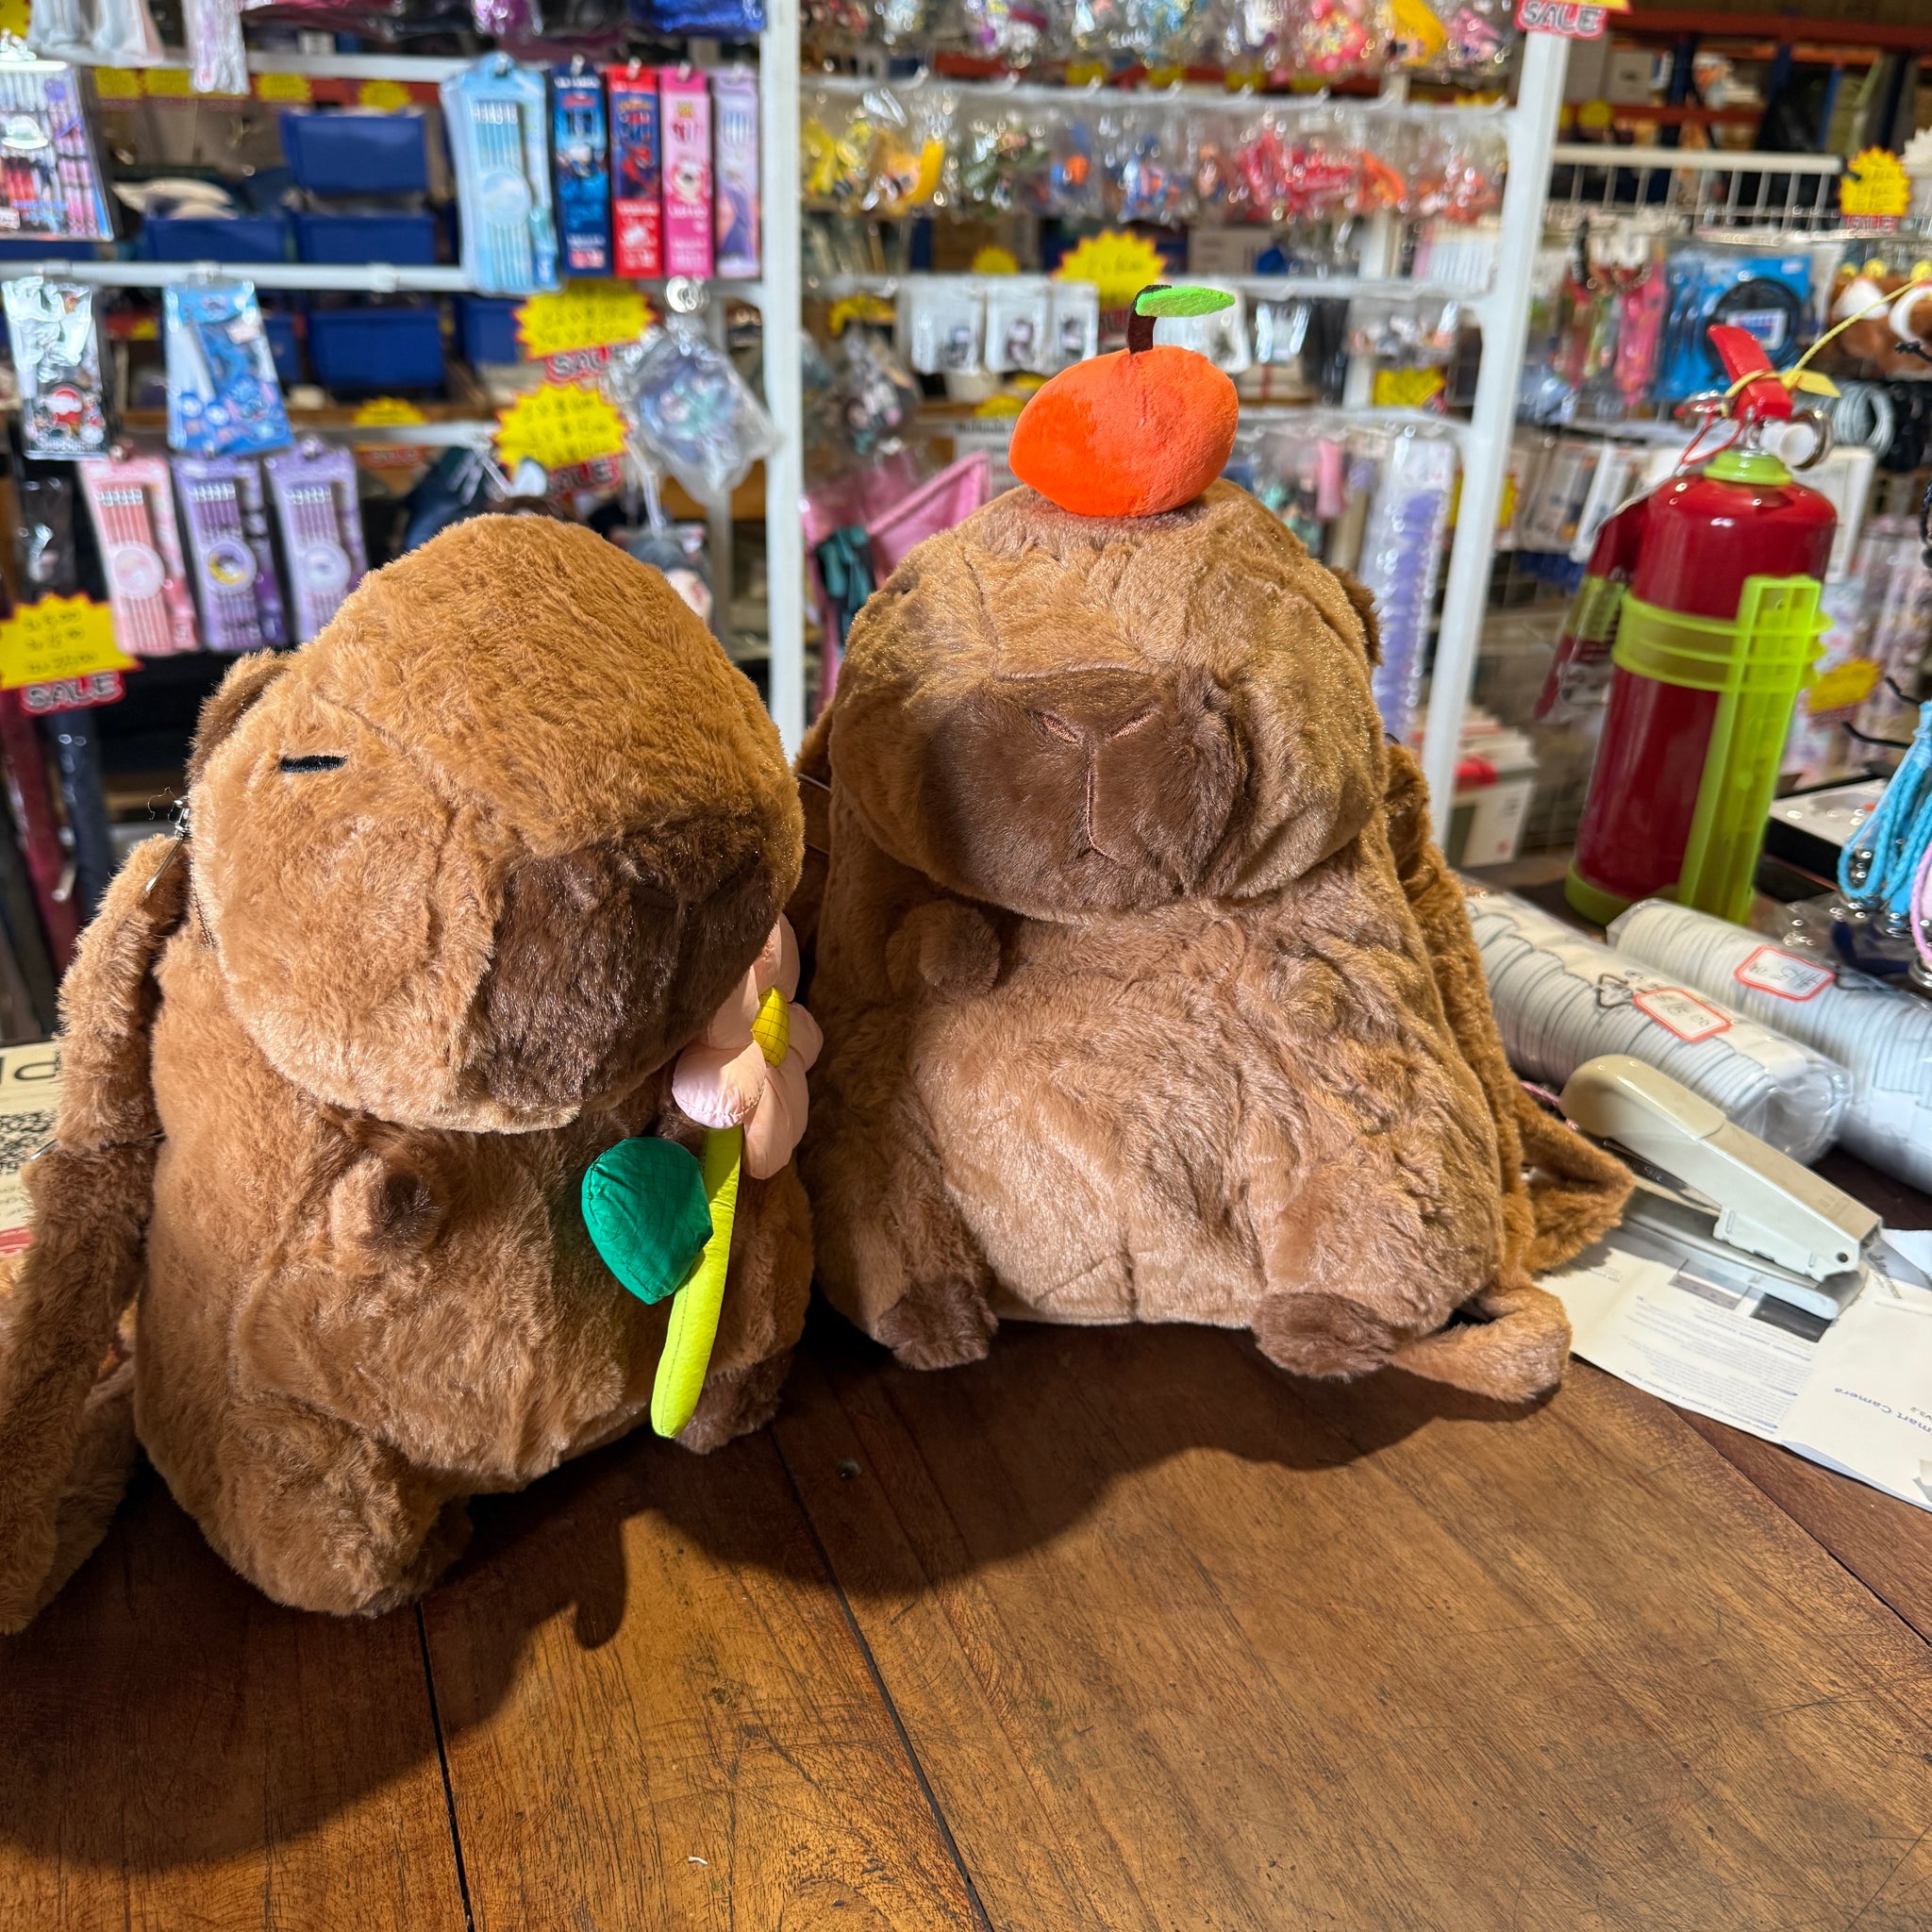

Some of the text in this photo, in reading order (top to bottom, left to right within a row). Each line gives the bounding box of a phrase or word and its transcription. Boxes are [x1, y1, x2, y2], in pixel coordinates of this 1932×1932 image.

[1522, 1, 1602, 34] SALE
[28, 674, 116, 708] SALE
[1834, 1387, 1932, 1436] mart Camera
